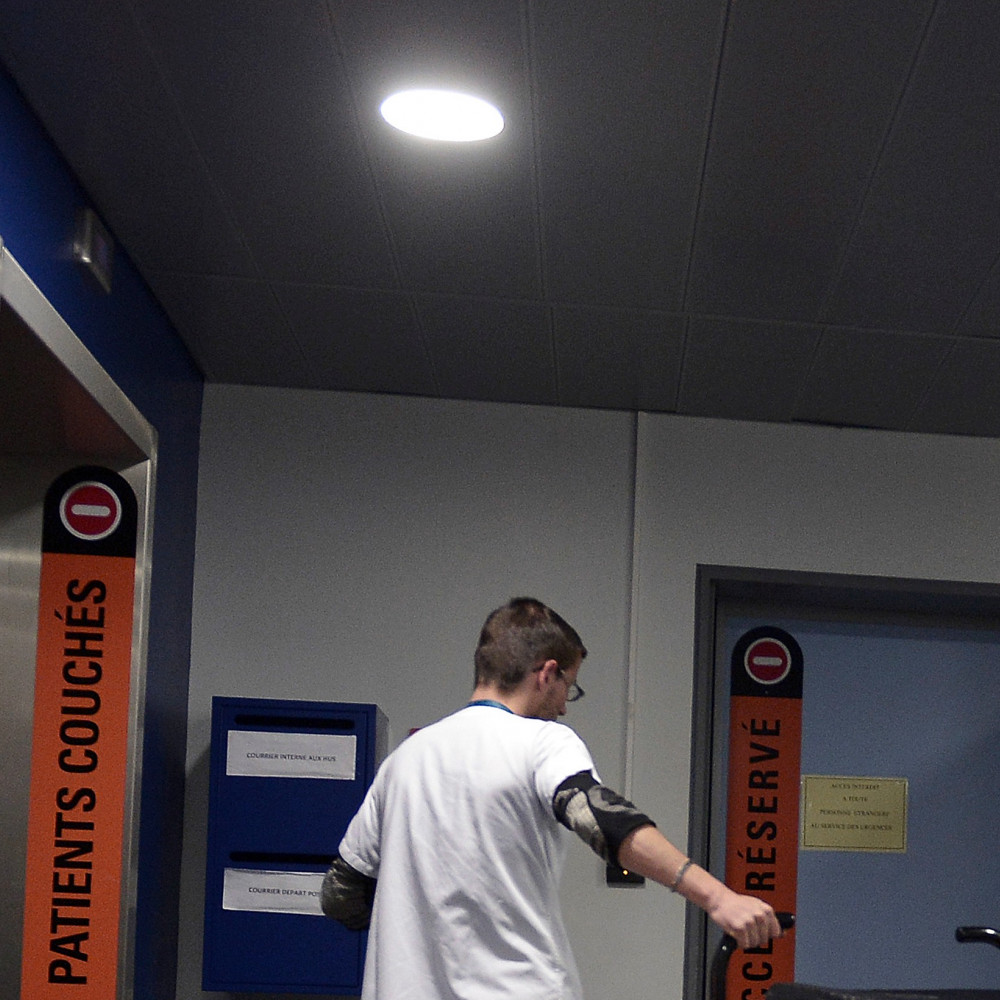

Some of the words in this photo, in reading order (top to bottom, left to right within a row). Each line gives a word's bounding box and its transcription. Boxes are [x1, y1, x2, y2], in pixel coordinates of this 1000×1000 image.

[54, 578, 107, 774] COUCHÉS
[246, 752, 279, 760] COURRIER
[280, 753, 307, 761] INTERNE
[47, 787, 97, 986] PATIENTS
[737, 718, 781, 891] RÉSERVÉ
[248, 886, 281, 895] COURRIER
[282, 889, 307, 897] DEPART
